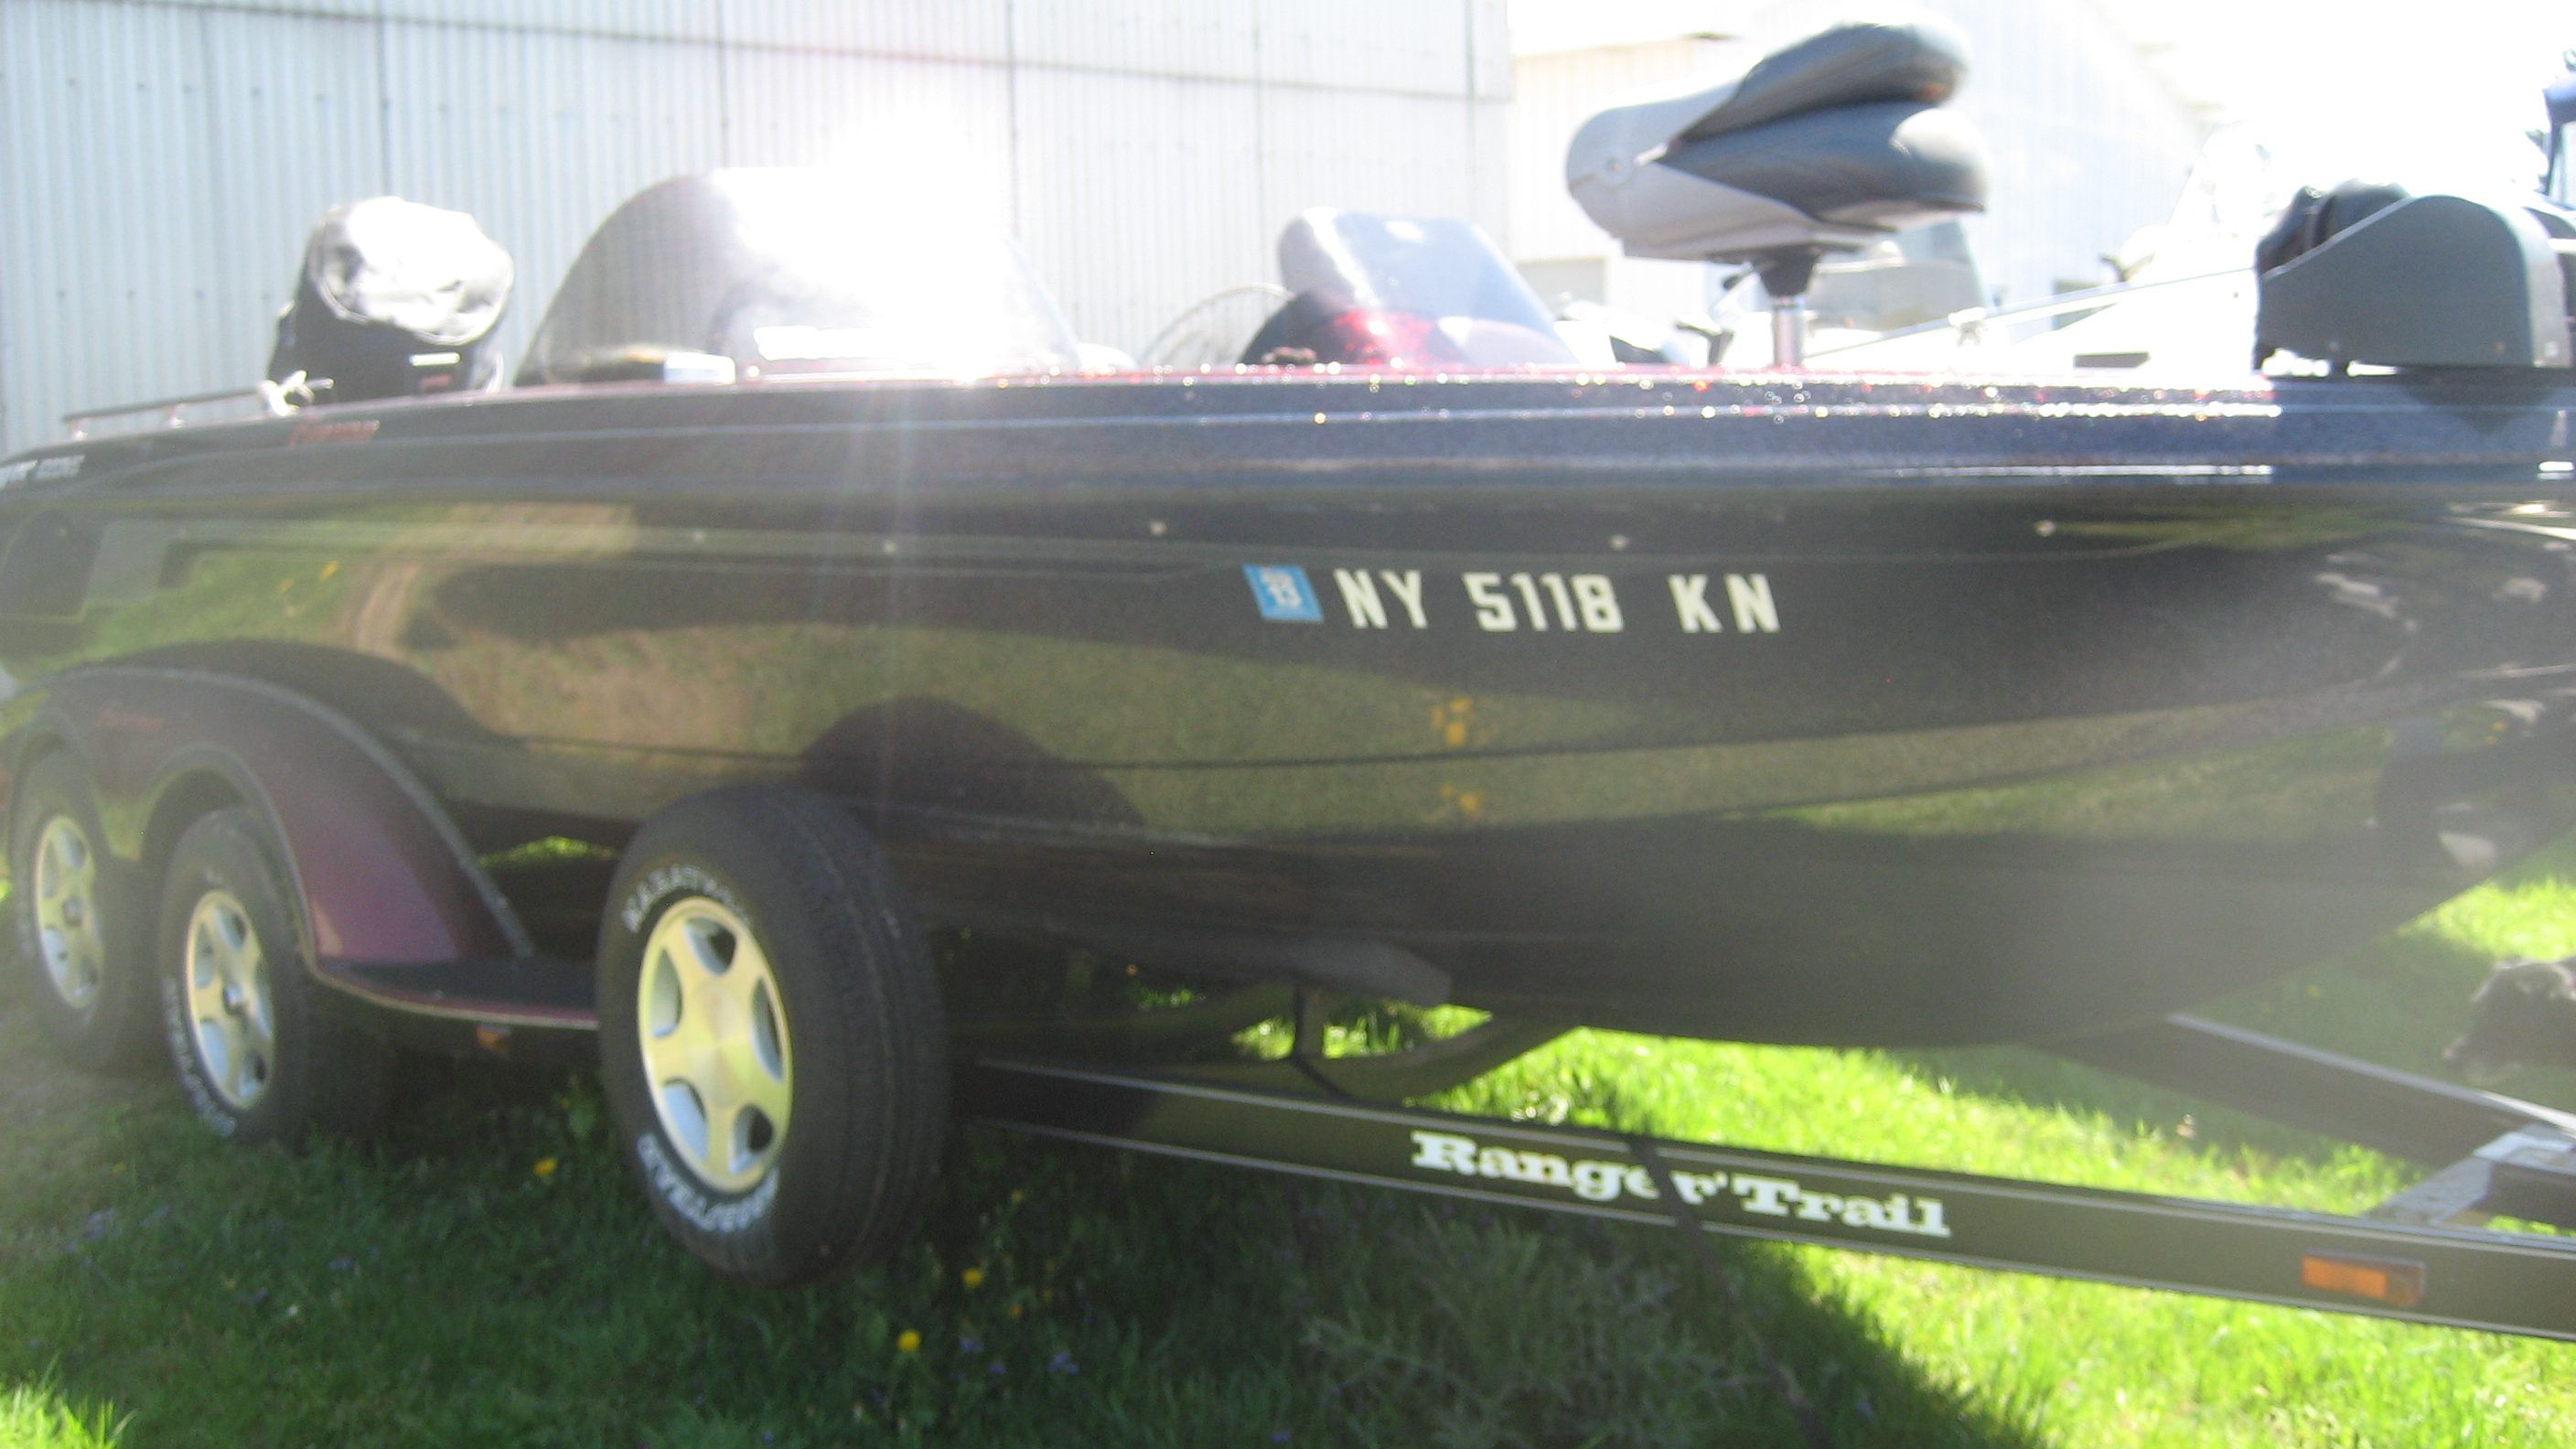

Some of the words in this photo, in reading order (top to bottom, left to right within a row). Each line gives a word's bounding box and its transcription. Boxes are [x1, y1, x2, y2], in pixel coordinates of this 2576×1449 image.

[1334, 567, 1428, 629] NY
[1464, 572, 1624, 633] 5118
[1669, 574, 1780, 633] KN
